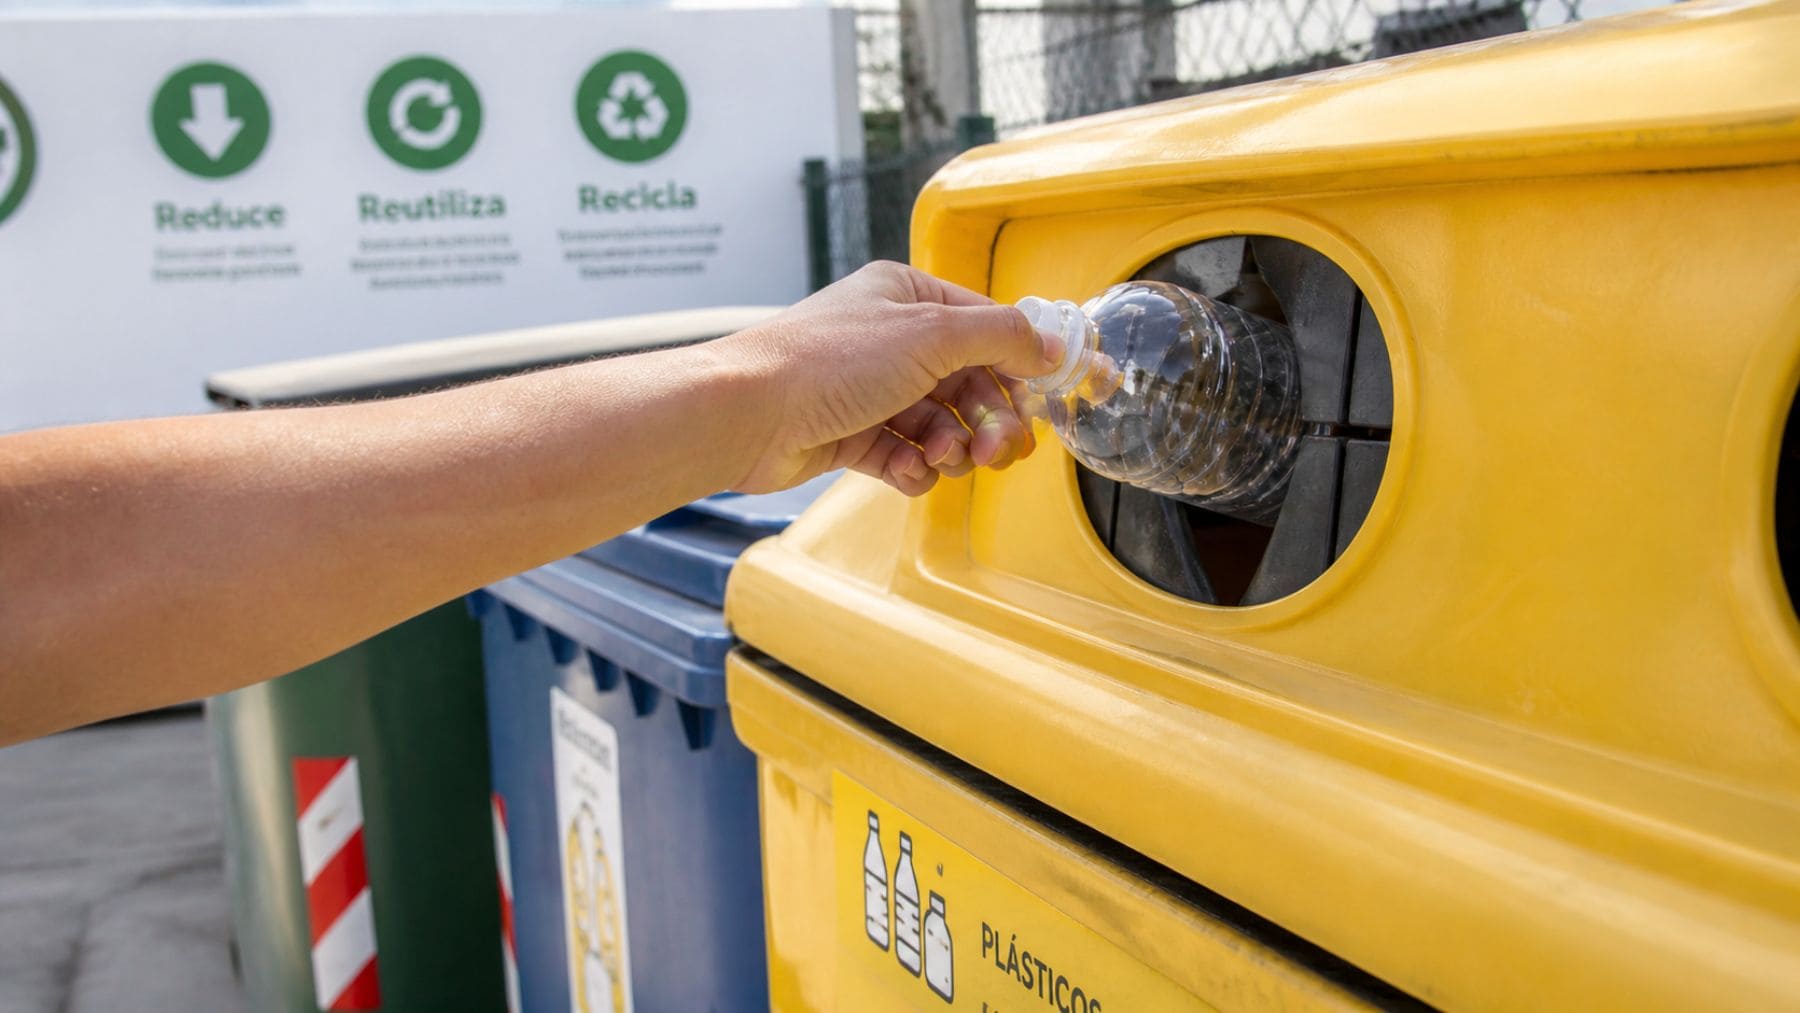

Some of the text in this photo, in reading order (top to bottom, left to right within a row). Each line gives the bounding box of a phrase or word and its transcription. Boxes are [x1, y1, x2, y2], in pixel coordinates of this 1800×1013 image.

[358, 189, 506, 221] Reutiliza
[577, 180, 698, 213] Recicla
[154, 199, 286, 230] Reduce
